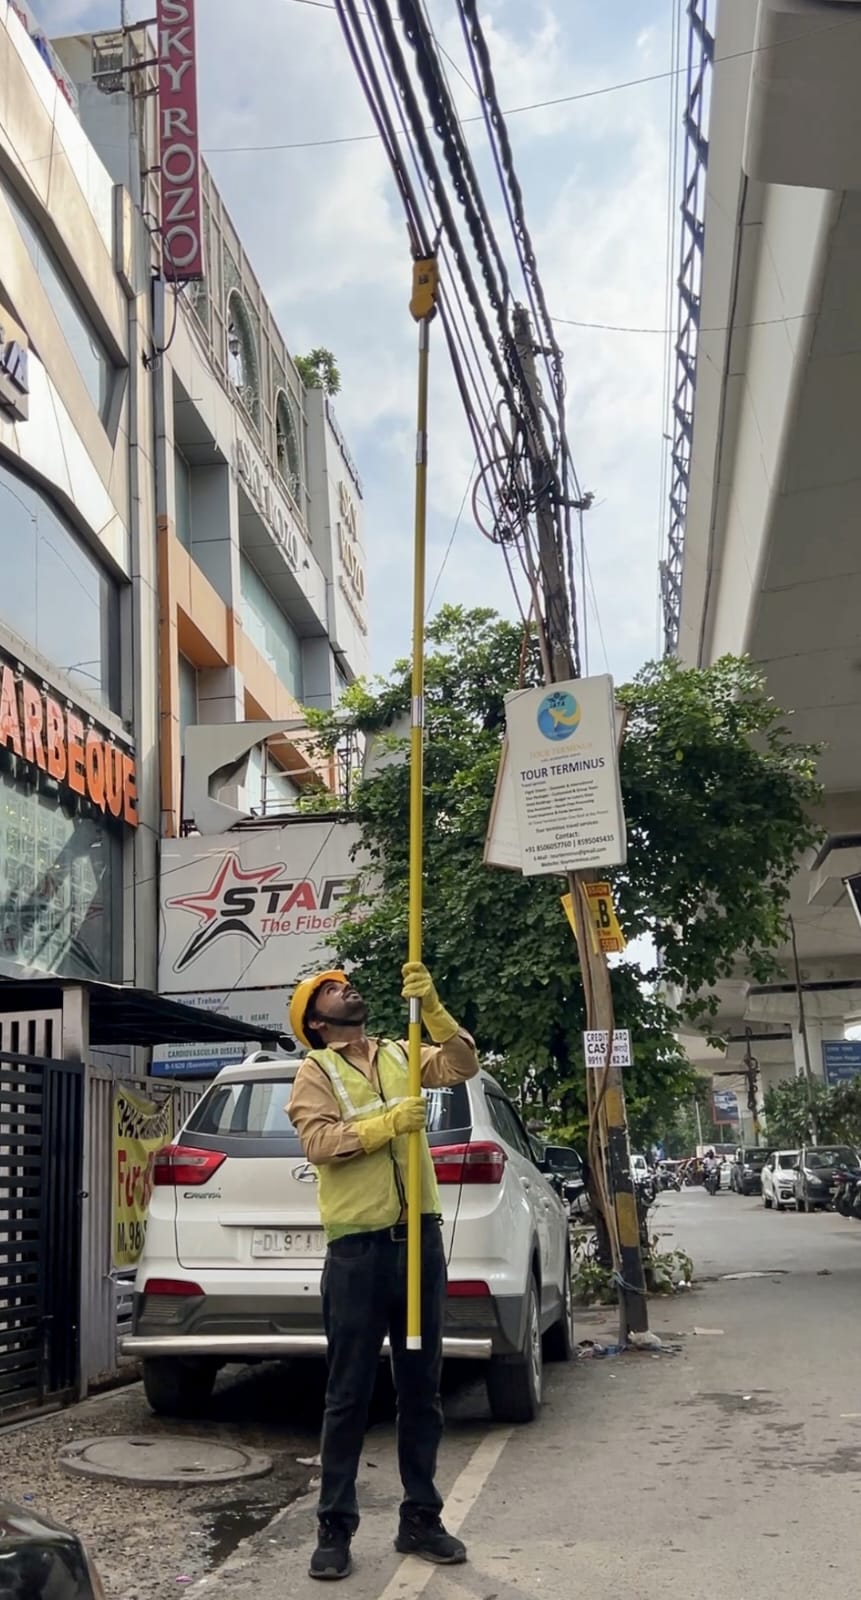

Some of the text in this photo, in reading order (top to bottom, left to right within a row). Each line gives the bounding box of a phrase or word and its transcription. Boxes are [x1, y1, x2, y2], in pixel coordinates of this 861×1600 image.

[161, 0, 199, 267] SKY ROZO
[520, 767, 549, 781] TOUR
[550, 757, 605, 776] TERMINUS
[260, 919, 290, 932] The
[296, 915, 338, 930] Fiber
[586, 1031, 628, 1042] CREDIT ARD
[587, 1043, 609, 1054] CAS
